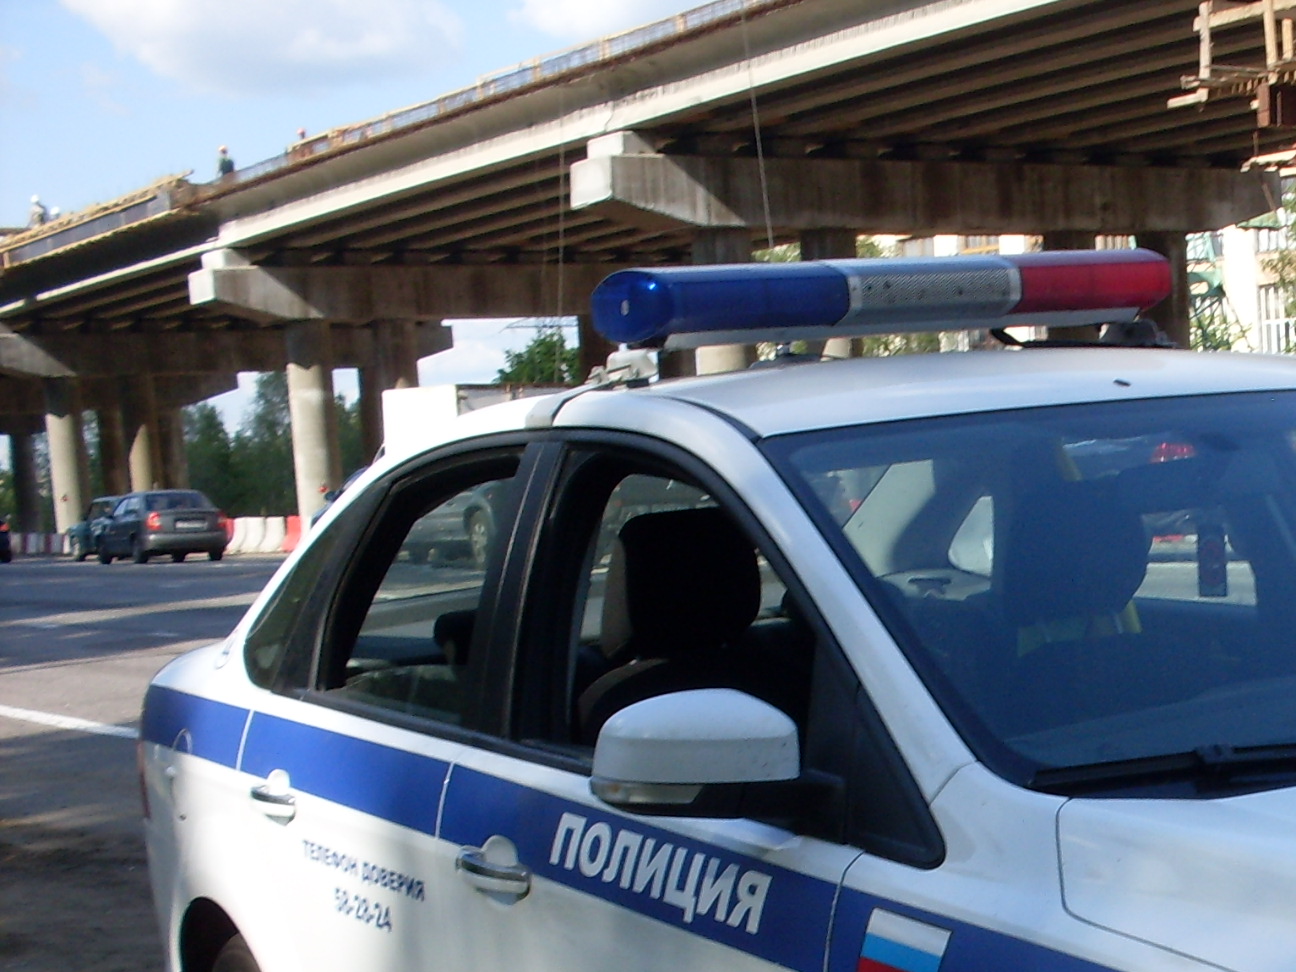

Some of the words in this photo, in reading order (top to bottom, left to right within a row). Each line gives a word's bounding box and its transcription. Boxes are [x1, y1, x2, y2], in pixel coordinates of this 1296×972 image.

[303, 839, 358, 877] ТЕЛЕФОН
[361, 861, 425, 903] ДОВЕРИЯ
[549, 811, 773, 935] ПОЛИЦИЯ
